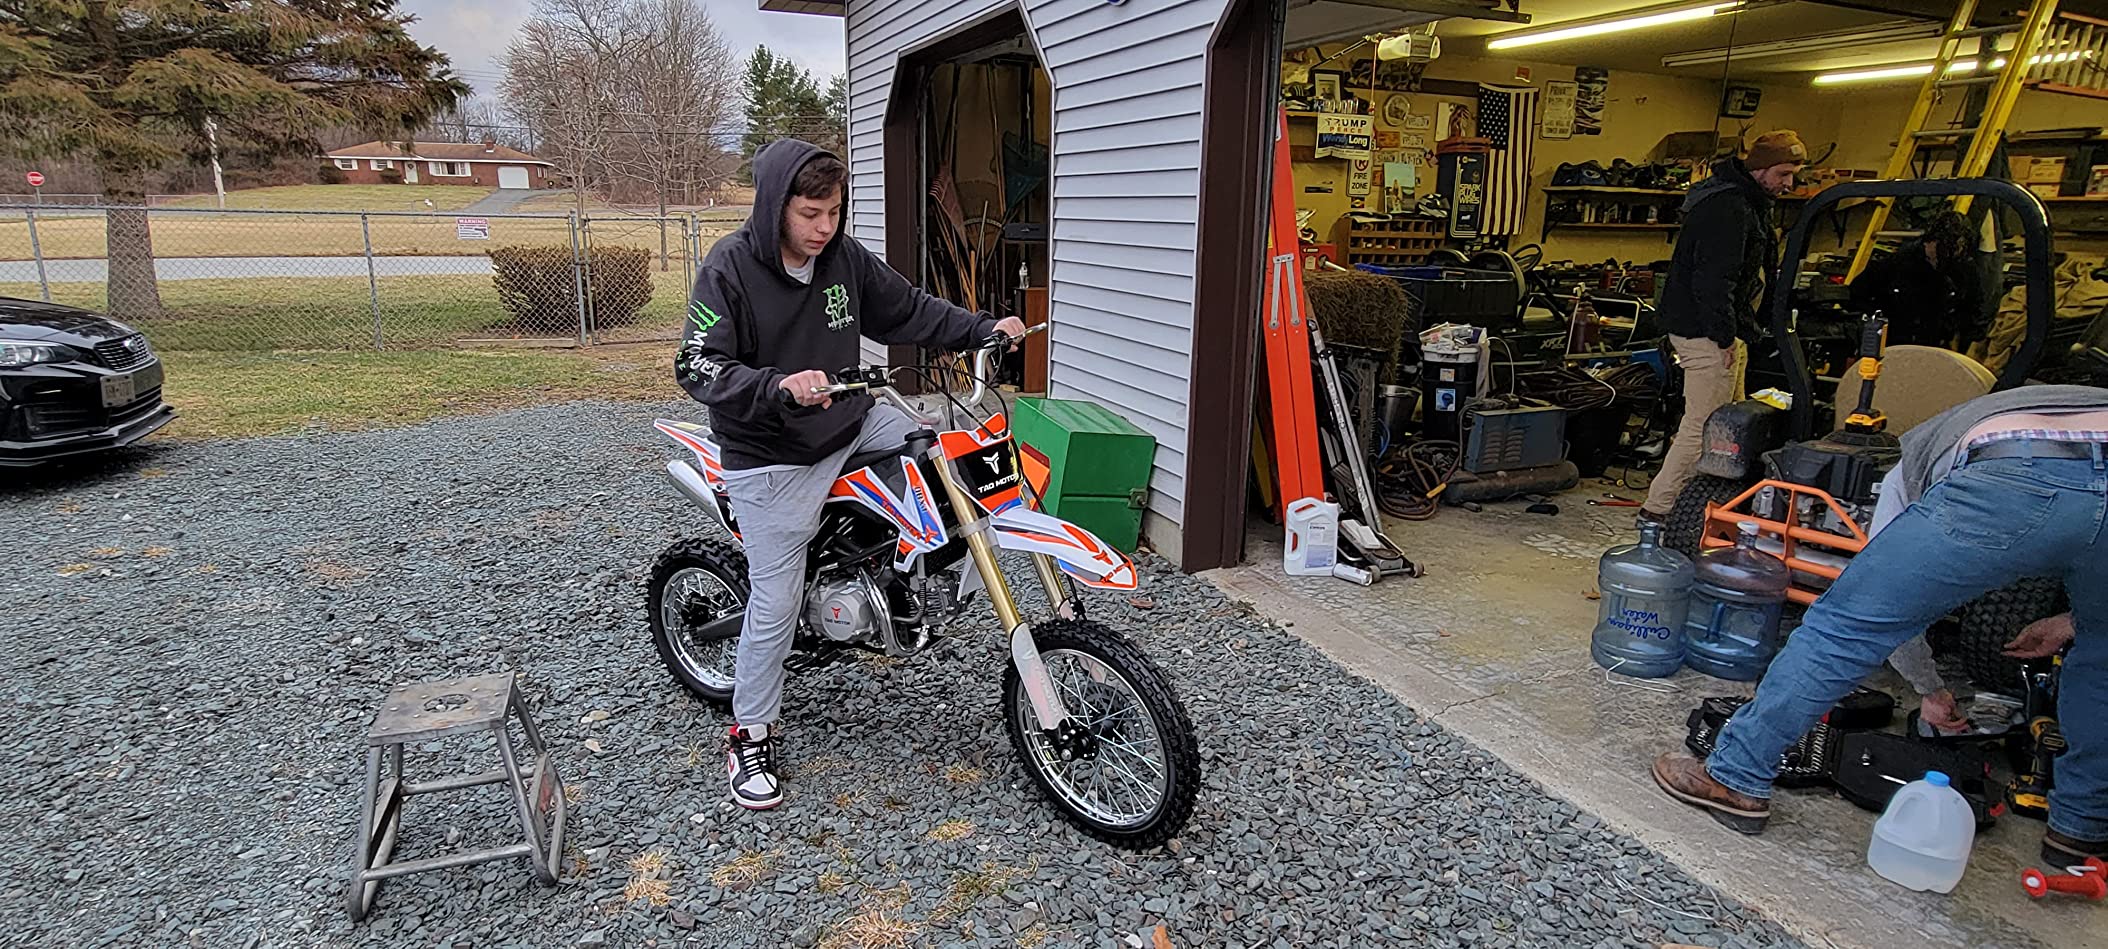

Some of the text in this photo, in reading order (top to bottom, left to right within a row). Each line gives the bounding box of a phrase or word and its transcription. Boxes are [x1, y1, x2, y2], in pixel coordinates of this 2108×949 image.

[1325, 117, 1367, 127] TRUMP
[1348, 135, 1368, 147] Long
[1353, 172, 1368, 180] FIRE
[1351, 182, 1369, 190] ZONE
[685, 330, 723, 381] MONER
[1621, 607, 1659, 625] Water
[1607, 617, 1671, 640] Culligan
